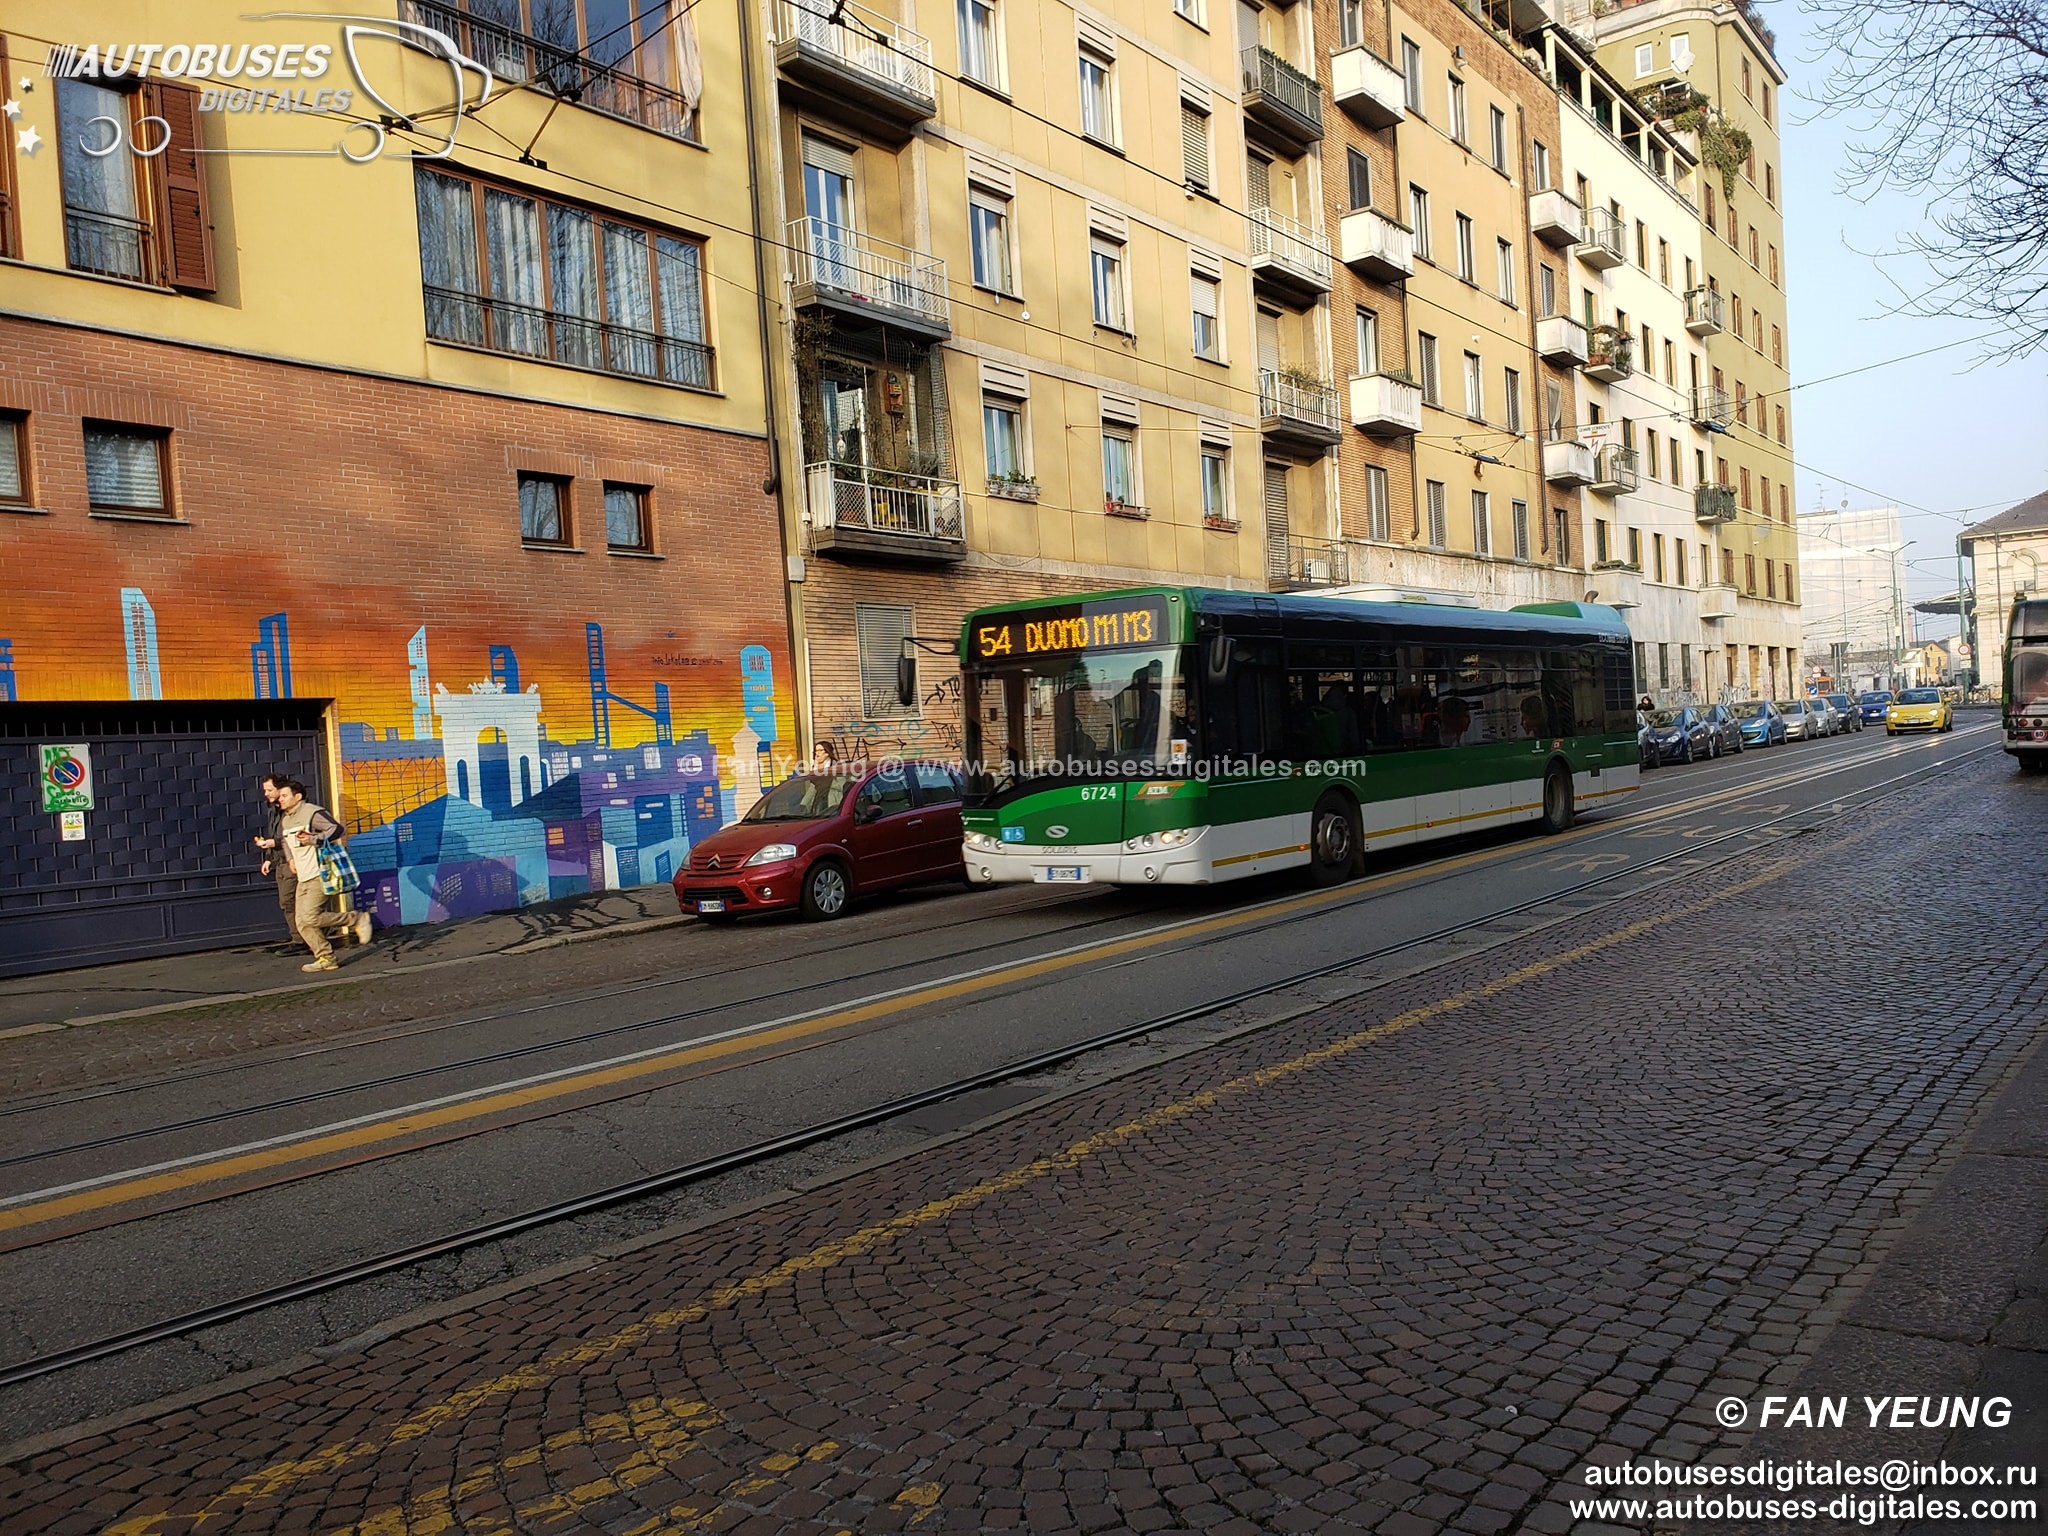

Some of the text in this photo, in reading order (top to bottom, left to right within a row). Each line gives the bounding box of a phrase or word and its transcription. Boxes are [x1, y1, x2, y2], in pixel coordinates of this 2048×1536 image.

[978, 610, 1152, 657] 54 DUOMO M1 M3
[1081, 786, 1117, 801] 6724
